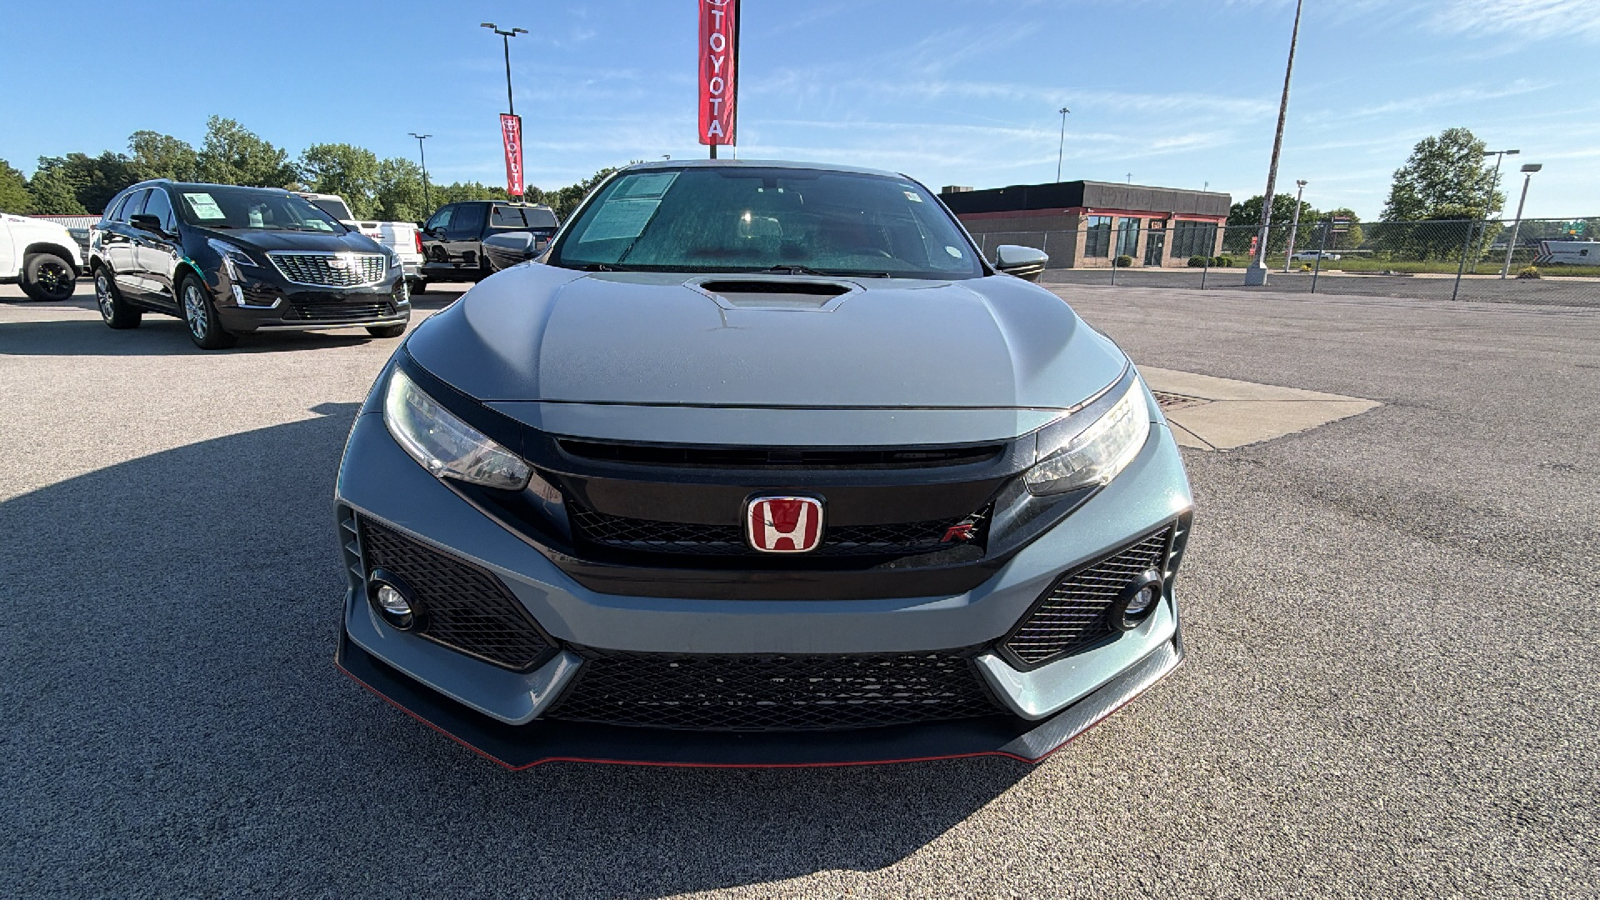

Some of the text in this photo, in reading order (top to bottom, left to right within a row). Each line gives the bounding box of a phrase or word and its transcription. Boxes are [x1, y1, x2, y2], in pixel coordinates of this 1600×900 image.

[707, 9, 726, 138] TOYOTA
[507, 132, 521, 193] TOYOTA
[940, 523, 973, 542] R
